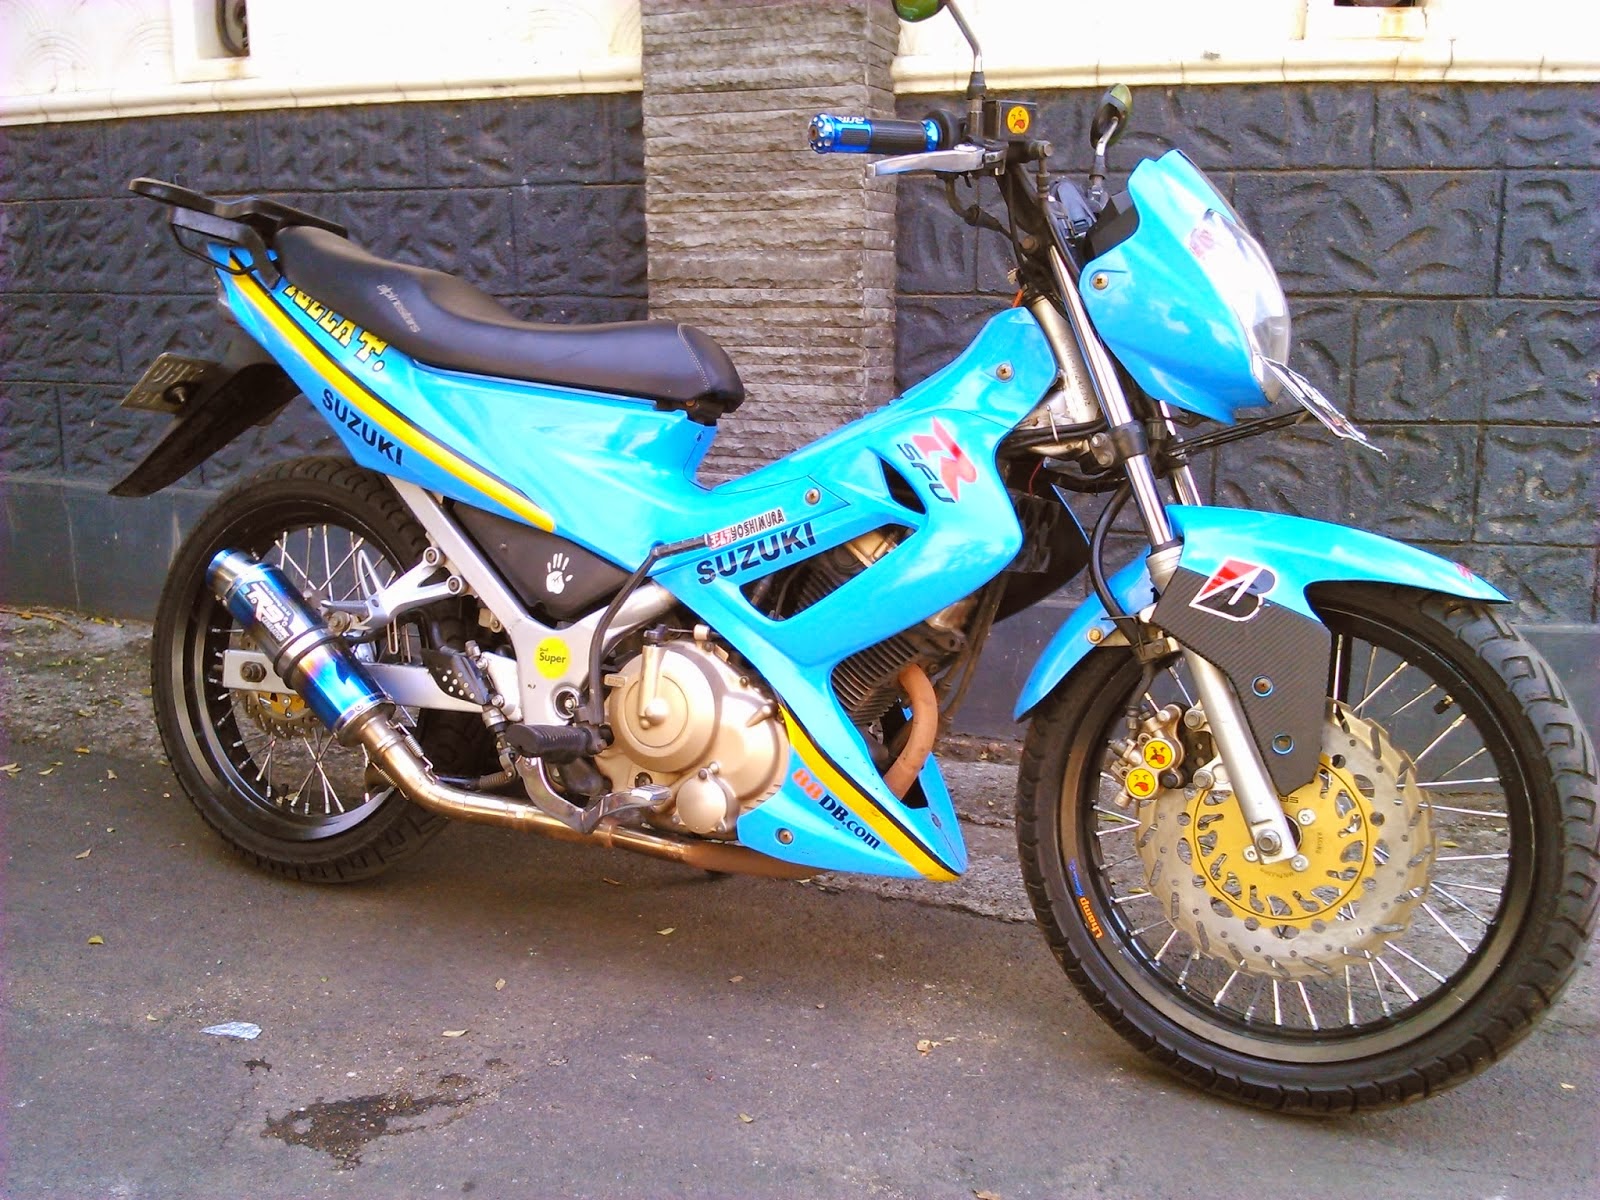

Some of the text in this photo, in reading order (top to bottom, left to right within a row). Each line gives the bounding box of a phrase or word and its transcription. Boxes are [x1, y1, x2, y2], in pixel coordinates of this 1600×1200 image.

[322, 388, 403, 467] SUZUKI
[897, 443, 956, 504] SFU
[696, 522, 817, 585] SUZUKI
[730, 509, 784, 541] YOSHIMURA
[539, 651, 567, 665] Super
